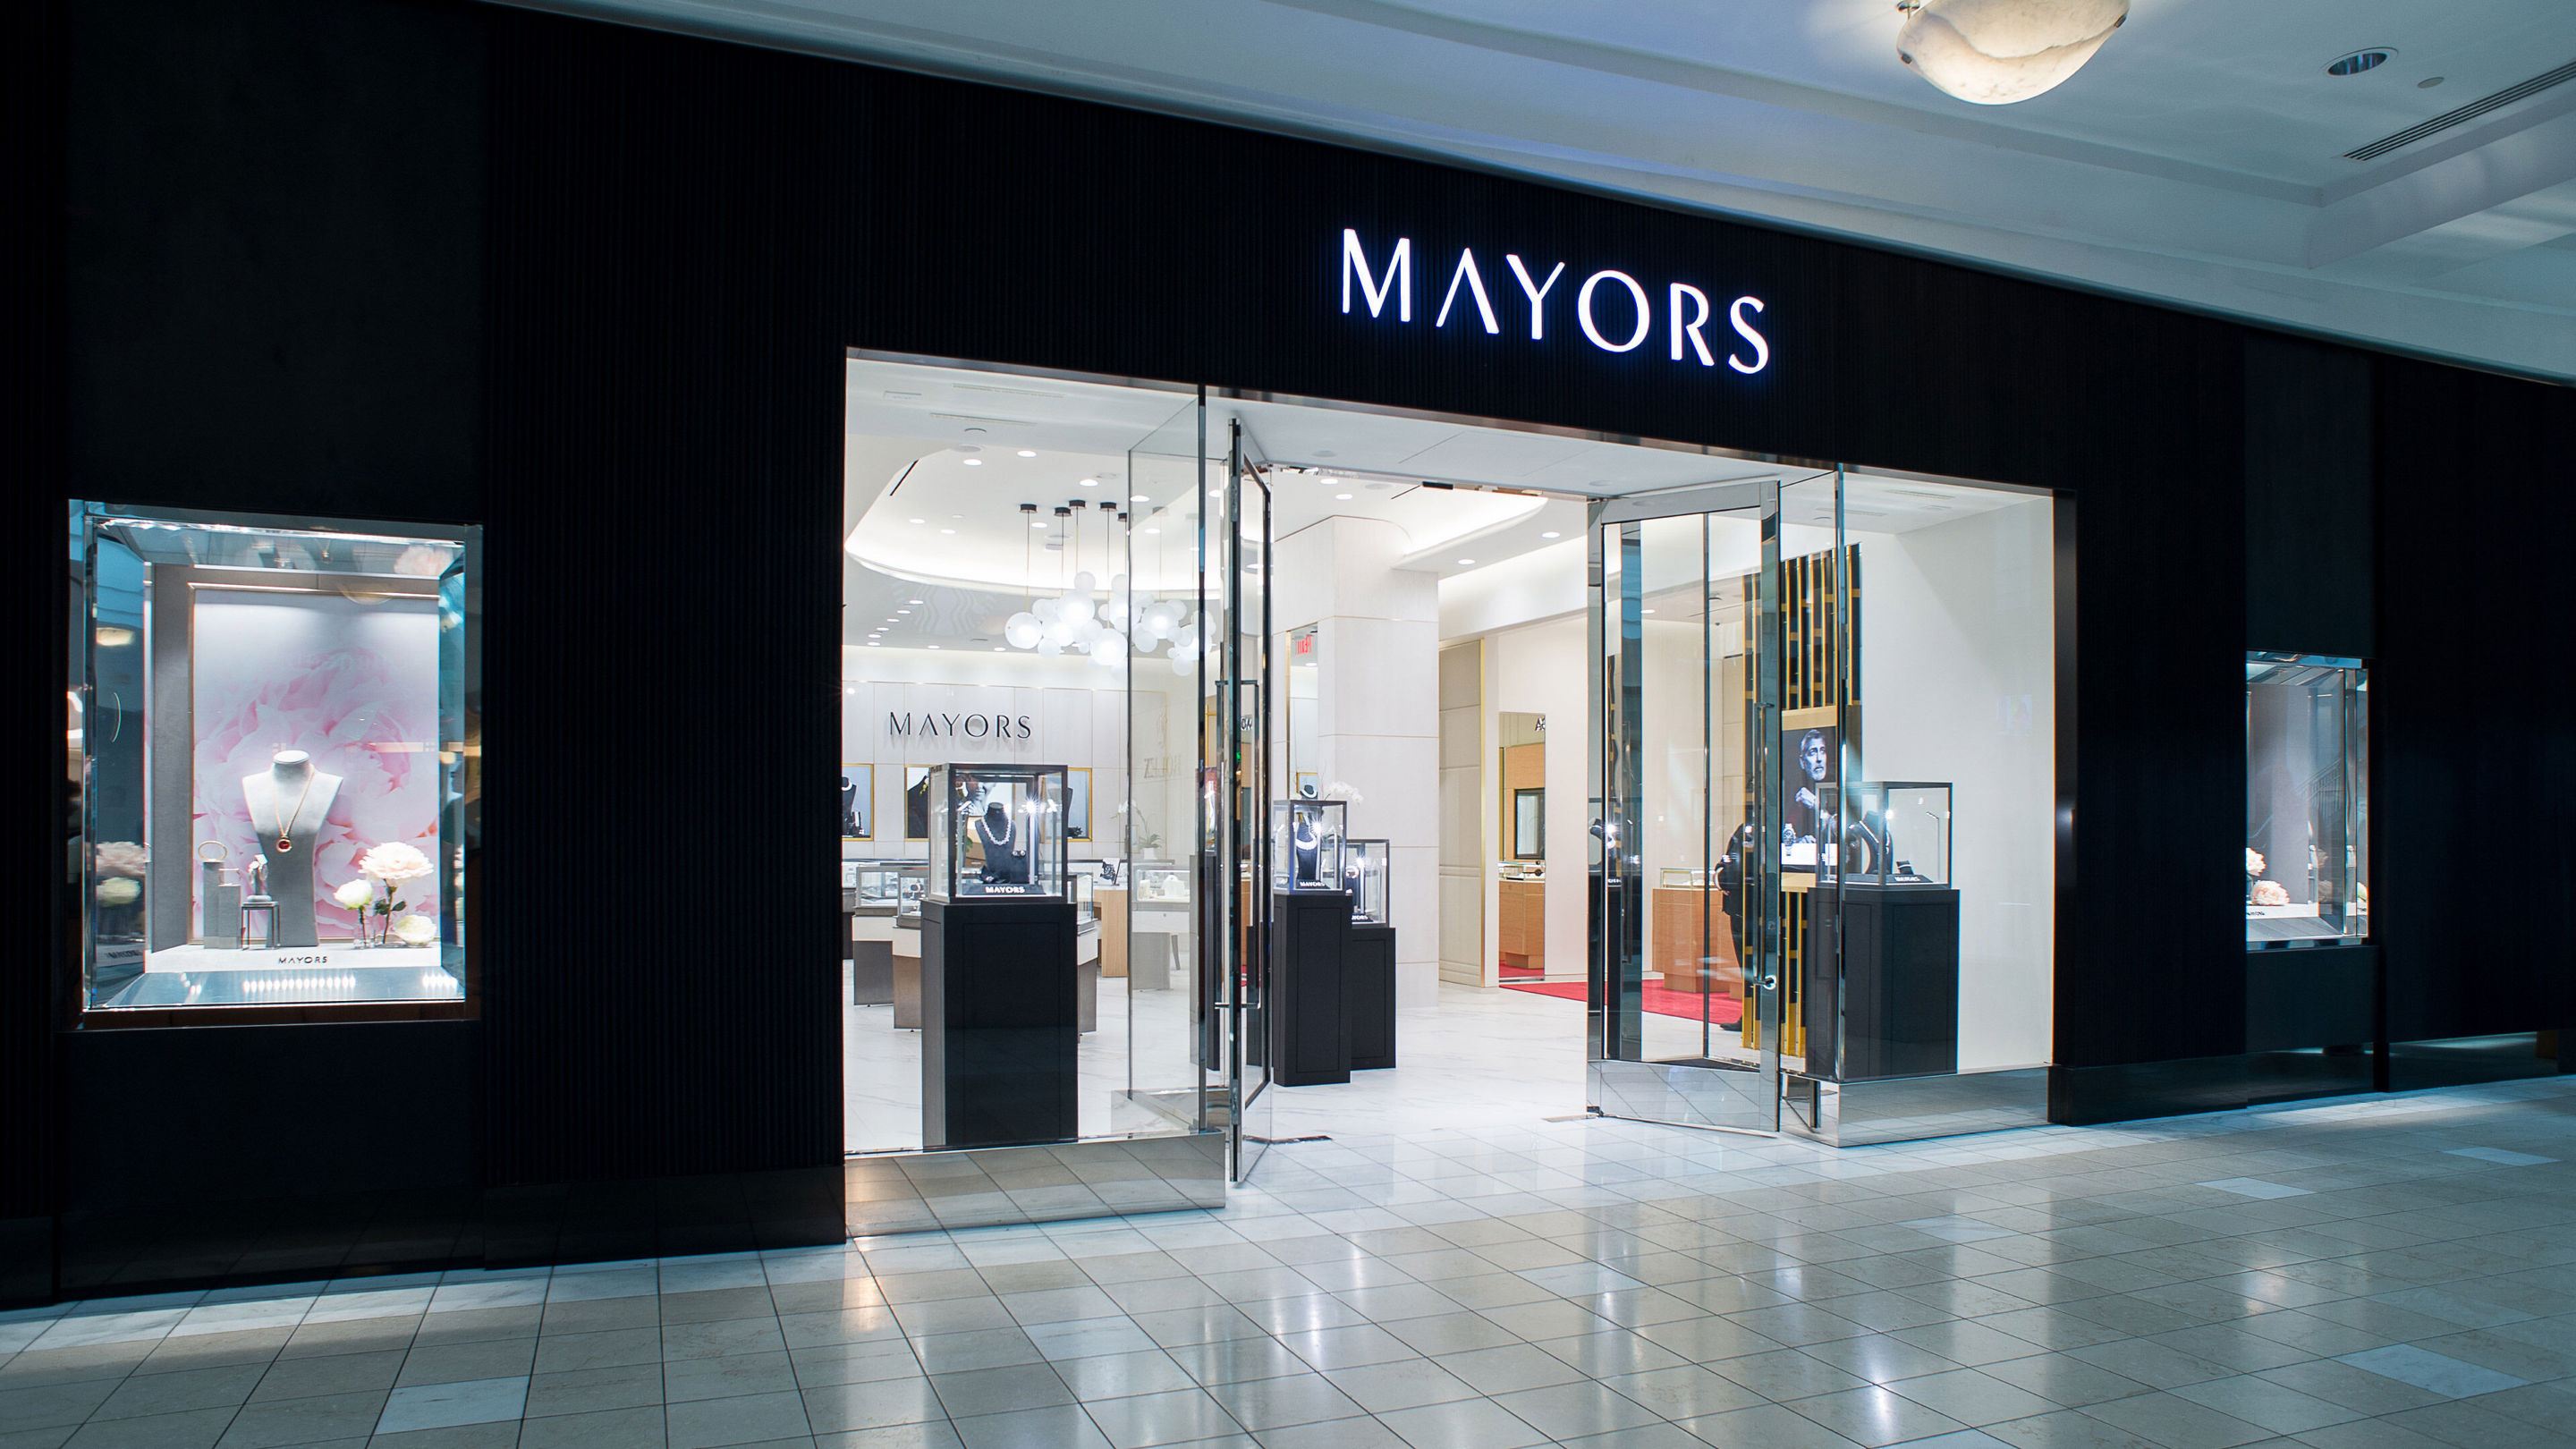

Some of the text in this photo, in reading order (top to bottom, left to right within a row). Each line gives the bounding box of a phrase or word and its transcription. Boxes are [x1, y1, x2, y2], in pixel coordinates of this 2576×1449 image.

[1342, 228, 1769, 375] MAYORS
[890, 711, 1031, 739] MAYORS
[985, 886, 1026, 894] MAYORS
[278, 955, 328, 965] MAYORS
